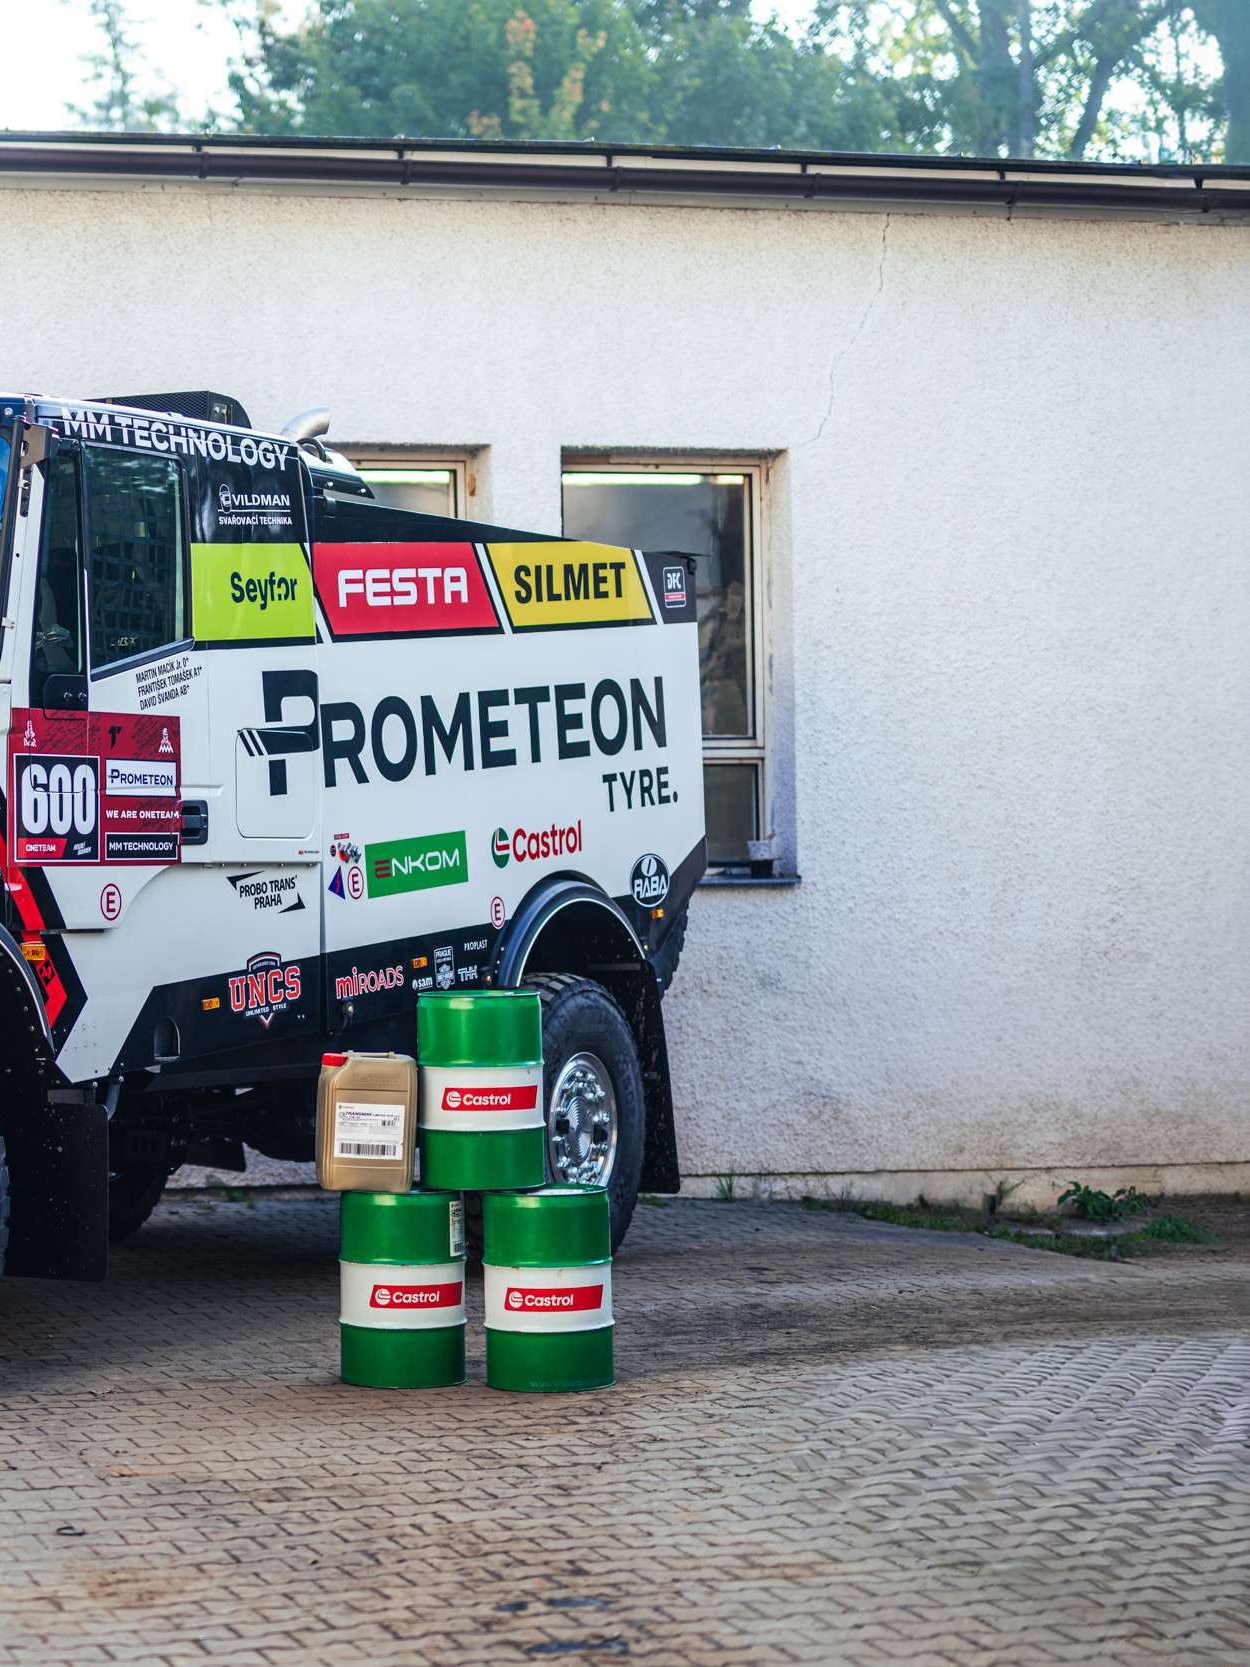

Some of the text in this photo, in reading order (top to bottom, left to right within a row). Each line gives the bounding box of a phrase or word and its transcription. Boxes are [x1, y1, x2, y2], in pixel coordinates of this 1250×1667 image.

[114, 416, 289, 471] TECHNOLOGY
[231, 494, 290, 506] VILDMAN
[259, 516, 292, 525] TECHNIKA
[230, 571, 297, 610] Seyfor
[338, 566, 468, 608] FESTA
[514, 562, 626, 604] SILMET
[135, 667, 157, 684] MARTIN
[139, 696, 157, 710] DAVID
[237, 669, 667, 796] PROMETEON
[108, 769, 173, 785] PROMETEON
[602, 767, 678, 812] TYRE.
[21, 763, 96, 835] 600
[106, 809, 180, 819] WE ARE ONETEAM
[123, 842, 174, 850] TECHNOLOGY
[512, 819, 582, 863] Castrol
[373, 847, 460, 879] ENKOM
[239, 876, 296, 898] PROBO TRANS
[254, 893, 283, 910] PRAHA
[229, 966, 301, 1011] UNCS
[272, 1003, 287, 1011] STYLE
[463, 1093, 511, 1107] Castrol
[393, 1290, 440, 1304] Castrol
[524, 1294, 574, 1307] Castrol
